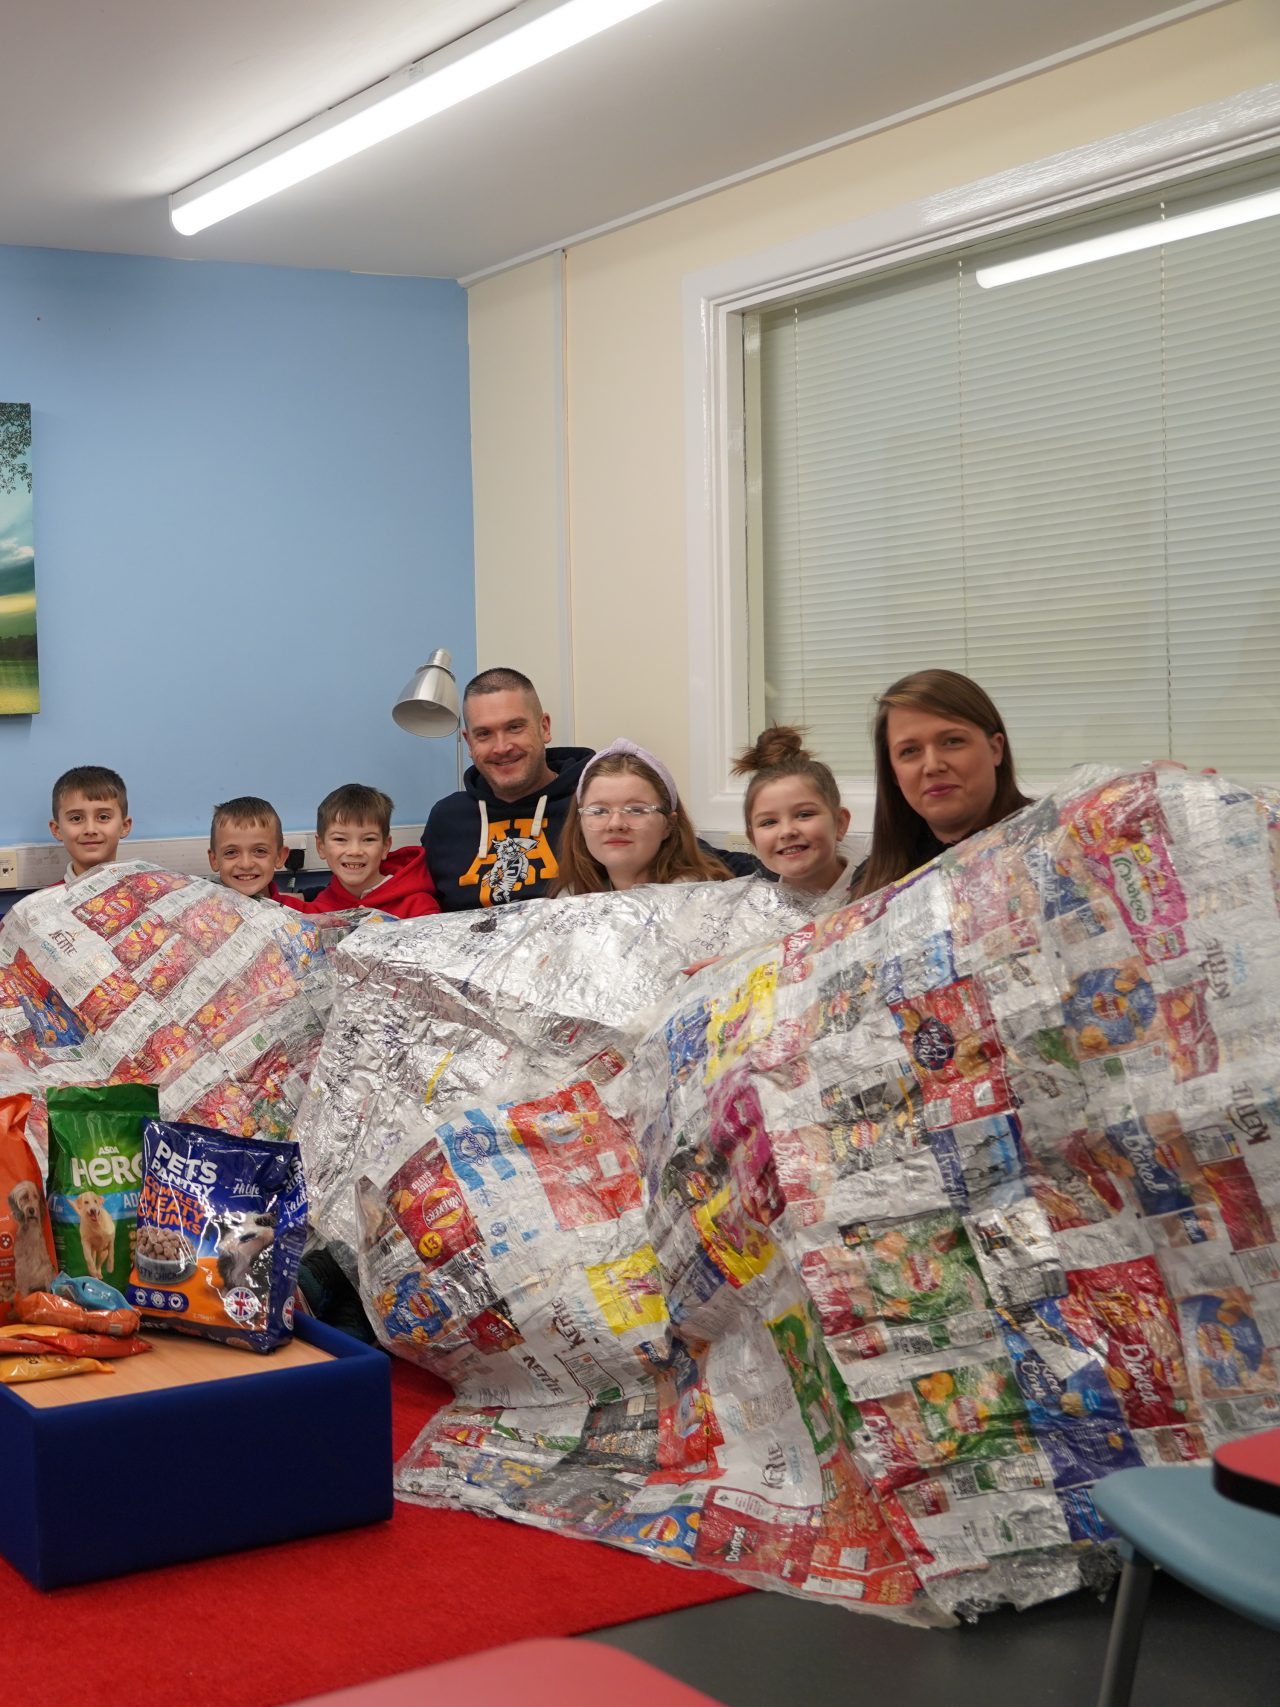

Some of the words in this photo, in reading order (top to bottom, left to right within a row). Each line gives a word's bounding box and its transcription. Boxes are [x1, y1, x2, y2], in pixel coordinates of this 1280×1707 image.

[98, 1146, 120, 1156] ASDA
[156, 1139, 218, 1185] PETS
[1122, 1134, 1170, 1194] Baked
[151, 1158, 216, 1197] PANTRY
[411, 1170, 433, 1190] SALTED
[417, 1176, 438, 1195] READY
[138, 1204, 202, 1236] CHUNKS
[140, 1186, 207, 1224] MEATY
[425, 1193, 464, 1225] WALKERS
[1120, 1344, 1162, 1408] Baked
[724, 1525, 746, 1563] Doritos
